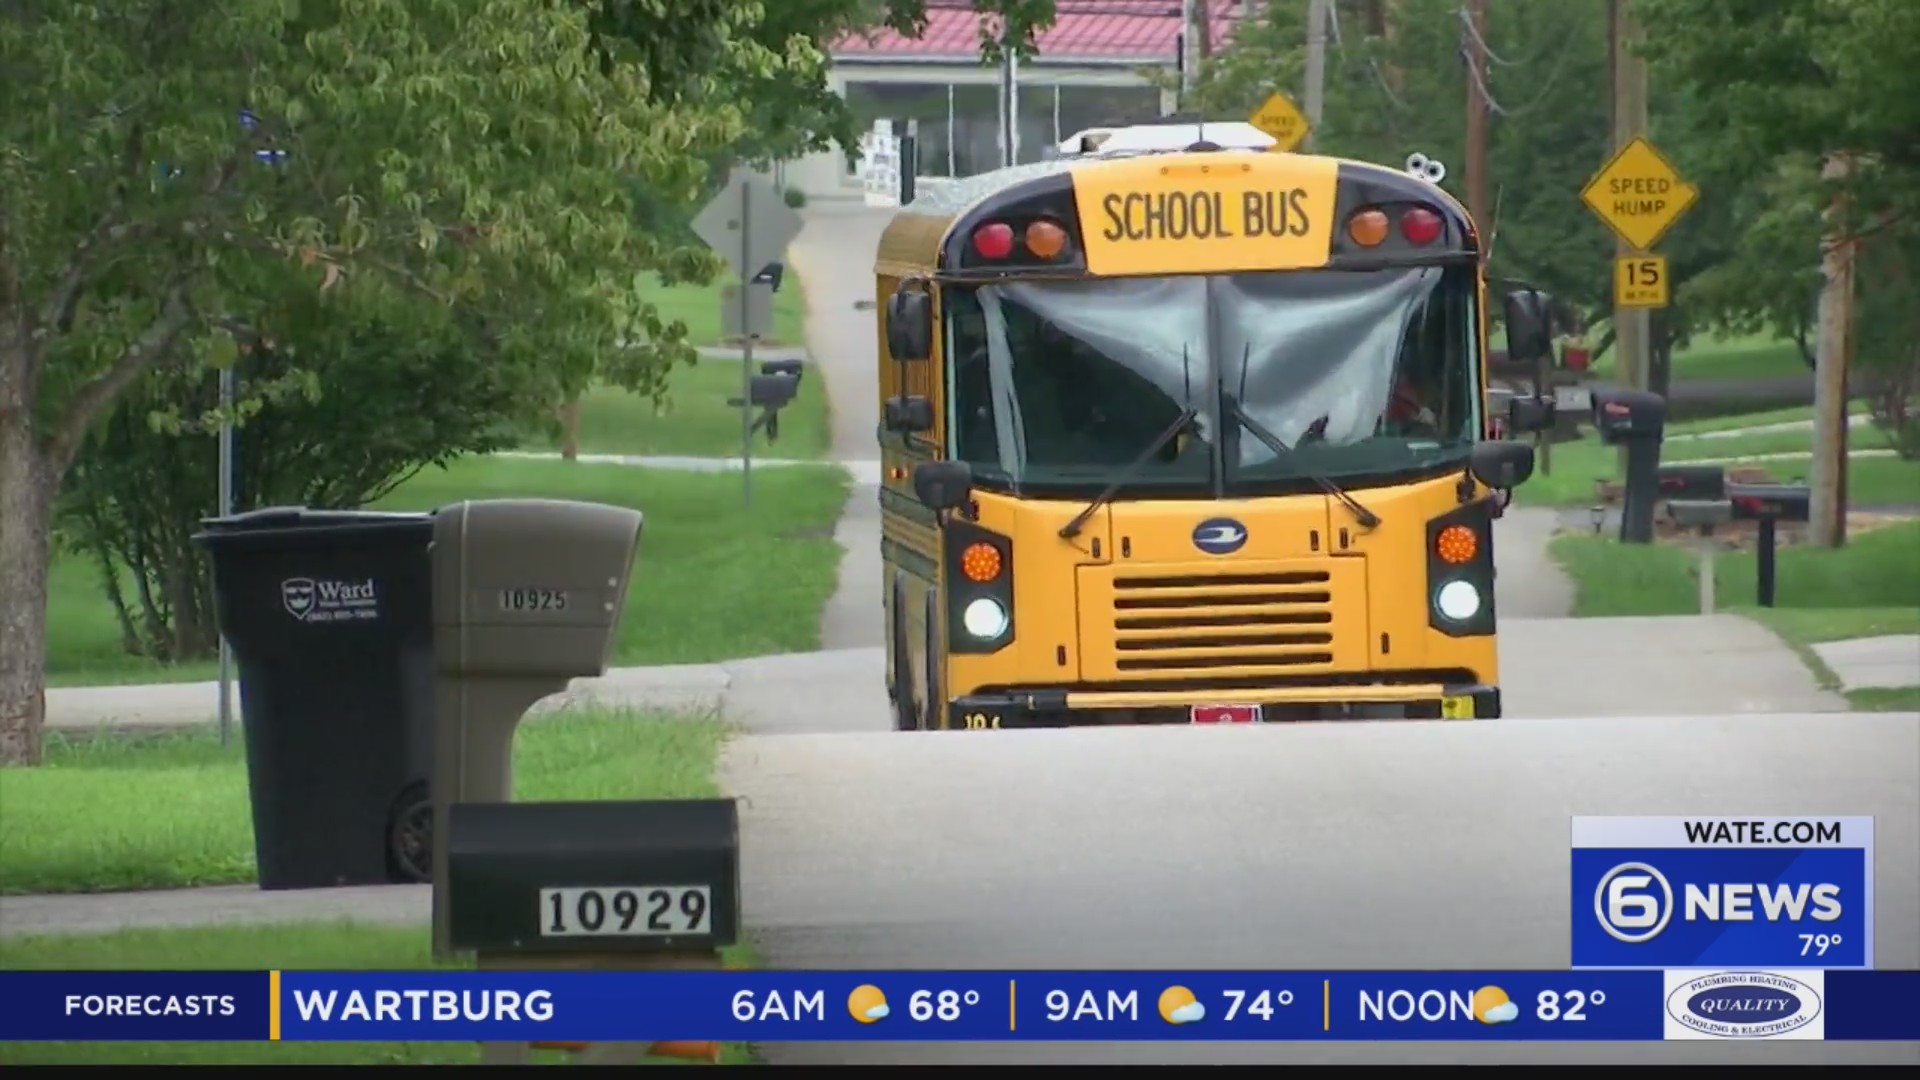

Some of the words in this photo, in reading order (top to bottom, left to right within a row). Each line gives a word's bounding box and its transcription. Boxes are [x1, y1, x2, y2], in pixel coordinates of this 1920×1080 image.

[1610, 178, 1670, 195] SPEED
[1103, 190, 1234, 242] SCHOOL
[1243, 187, 1310, 237] BUS
[1613, 199, 1666, 216] HUMP
[1627, 261, 1659, 286] 15
[318, 578, 374, 600] Ward
[504, 590, 566, 611] 10925
[549, 889, 706, 933] 10929
